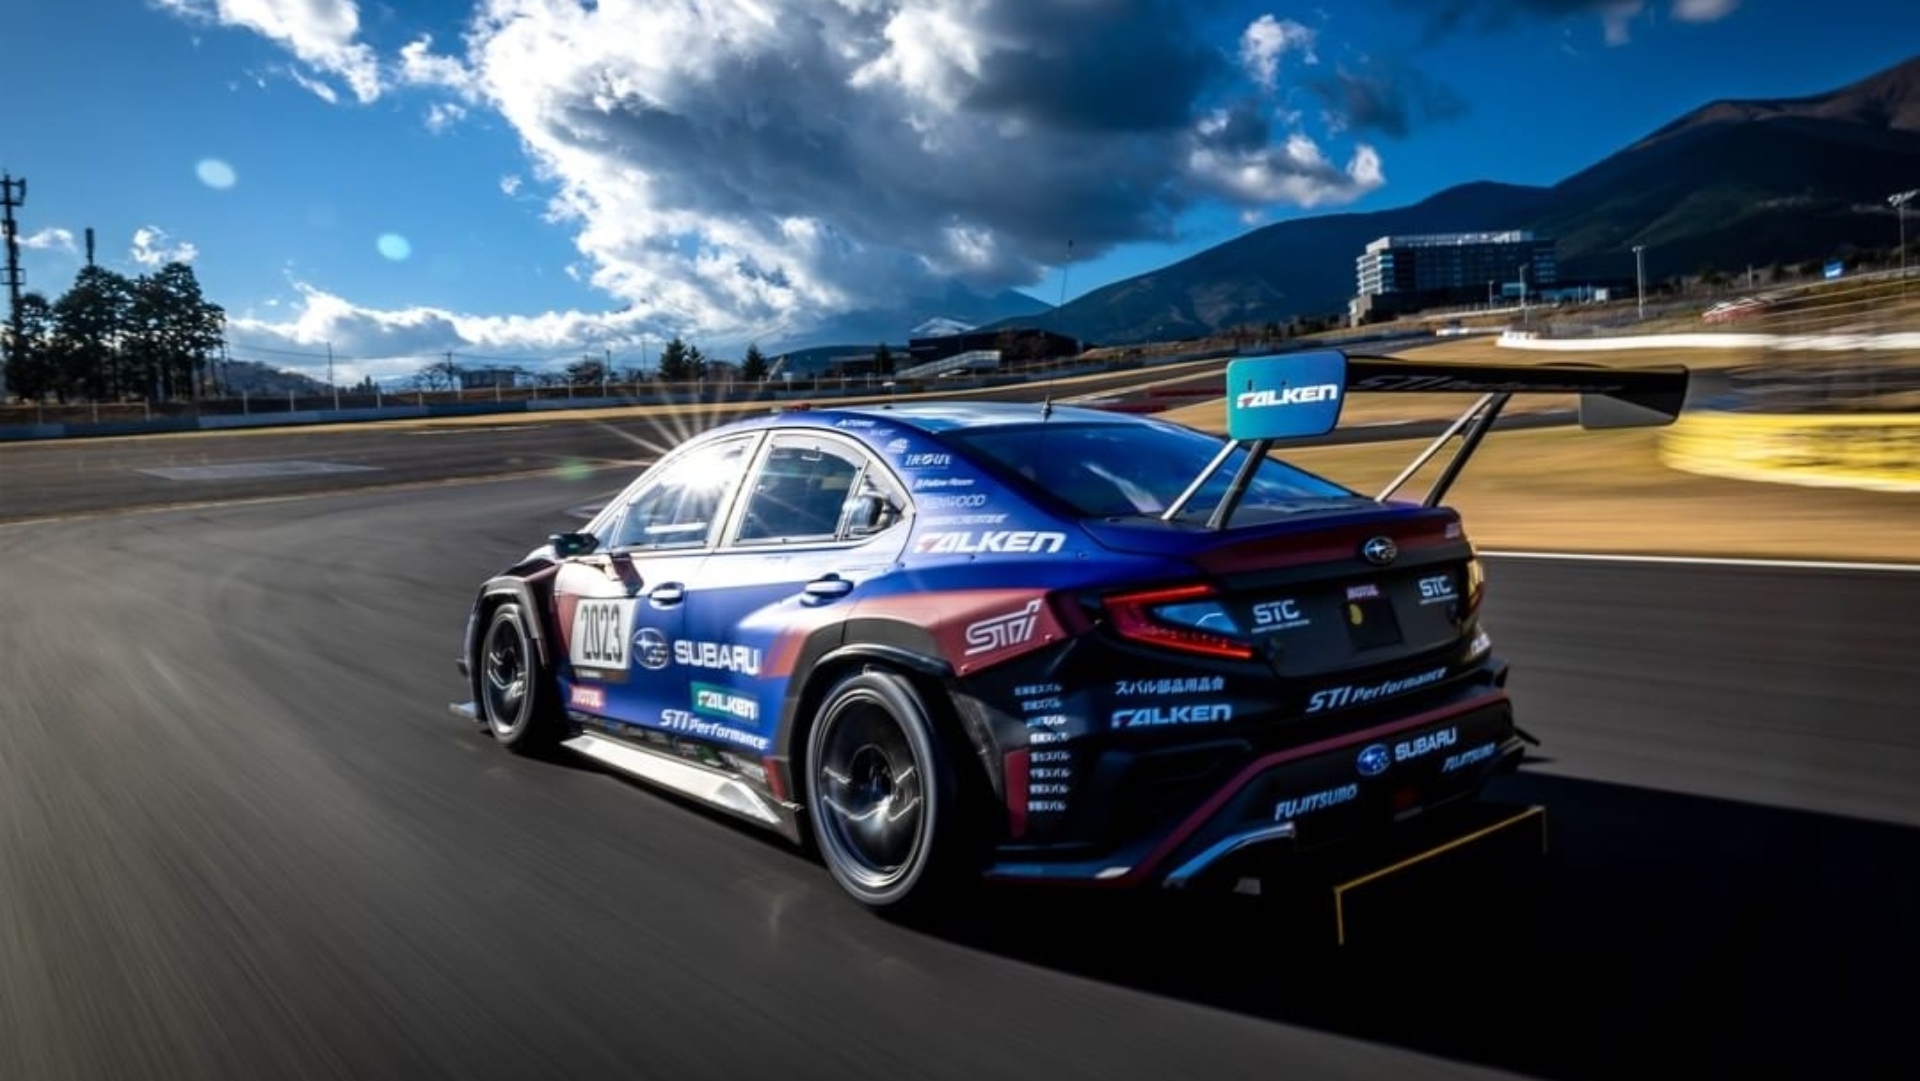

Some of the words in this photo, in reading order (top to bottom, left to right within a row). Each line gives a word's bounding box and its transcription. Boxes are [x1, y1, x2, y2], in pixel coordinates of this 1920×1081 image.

[1237, 384, 1338, 409] FALKEN
[913, 531, 1067, 554] FALKEN
[1419, 575, 1452, 597] STC
[1252, 600, 1301, 625] STC
[581, 604, 623, 663] 2023
[674, 640, 760, 675] SUBARU
[697, 691, 759, 719] FALKEN
[1306, 686, 1352, 713] STI
[1351, 667, 1447, 703] Performance
[660, 709, 689, 729] STI
[690, 719, 769, 750] Performance
[1111, 703, 1232, 728] FALKEN
[1395, 727, 1458, 762] SUBARU
[1275, 783, 1358, 821] FUJITSUBO
